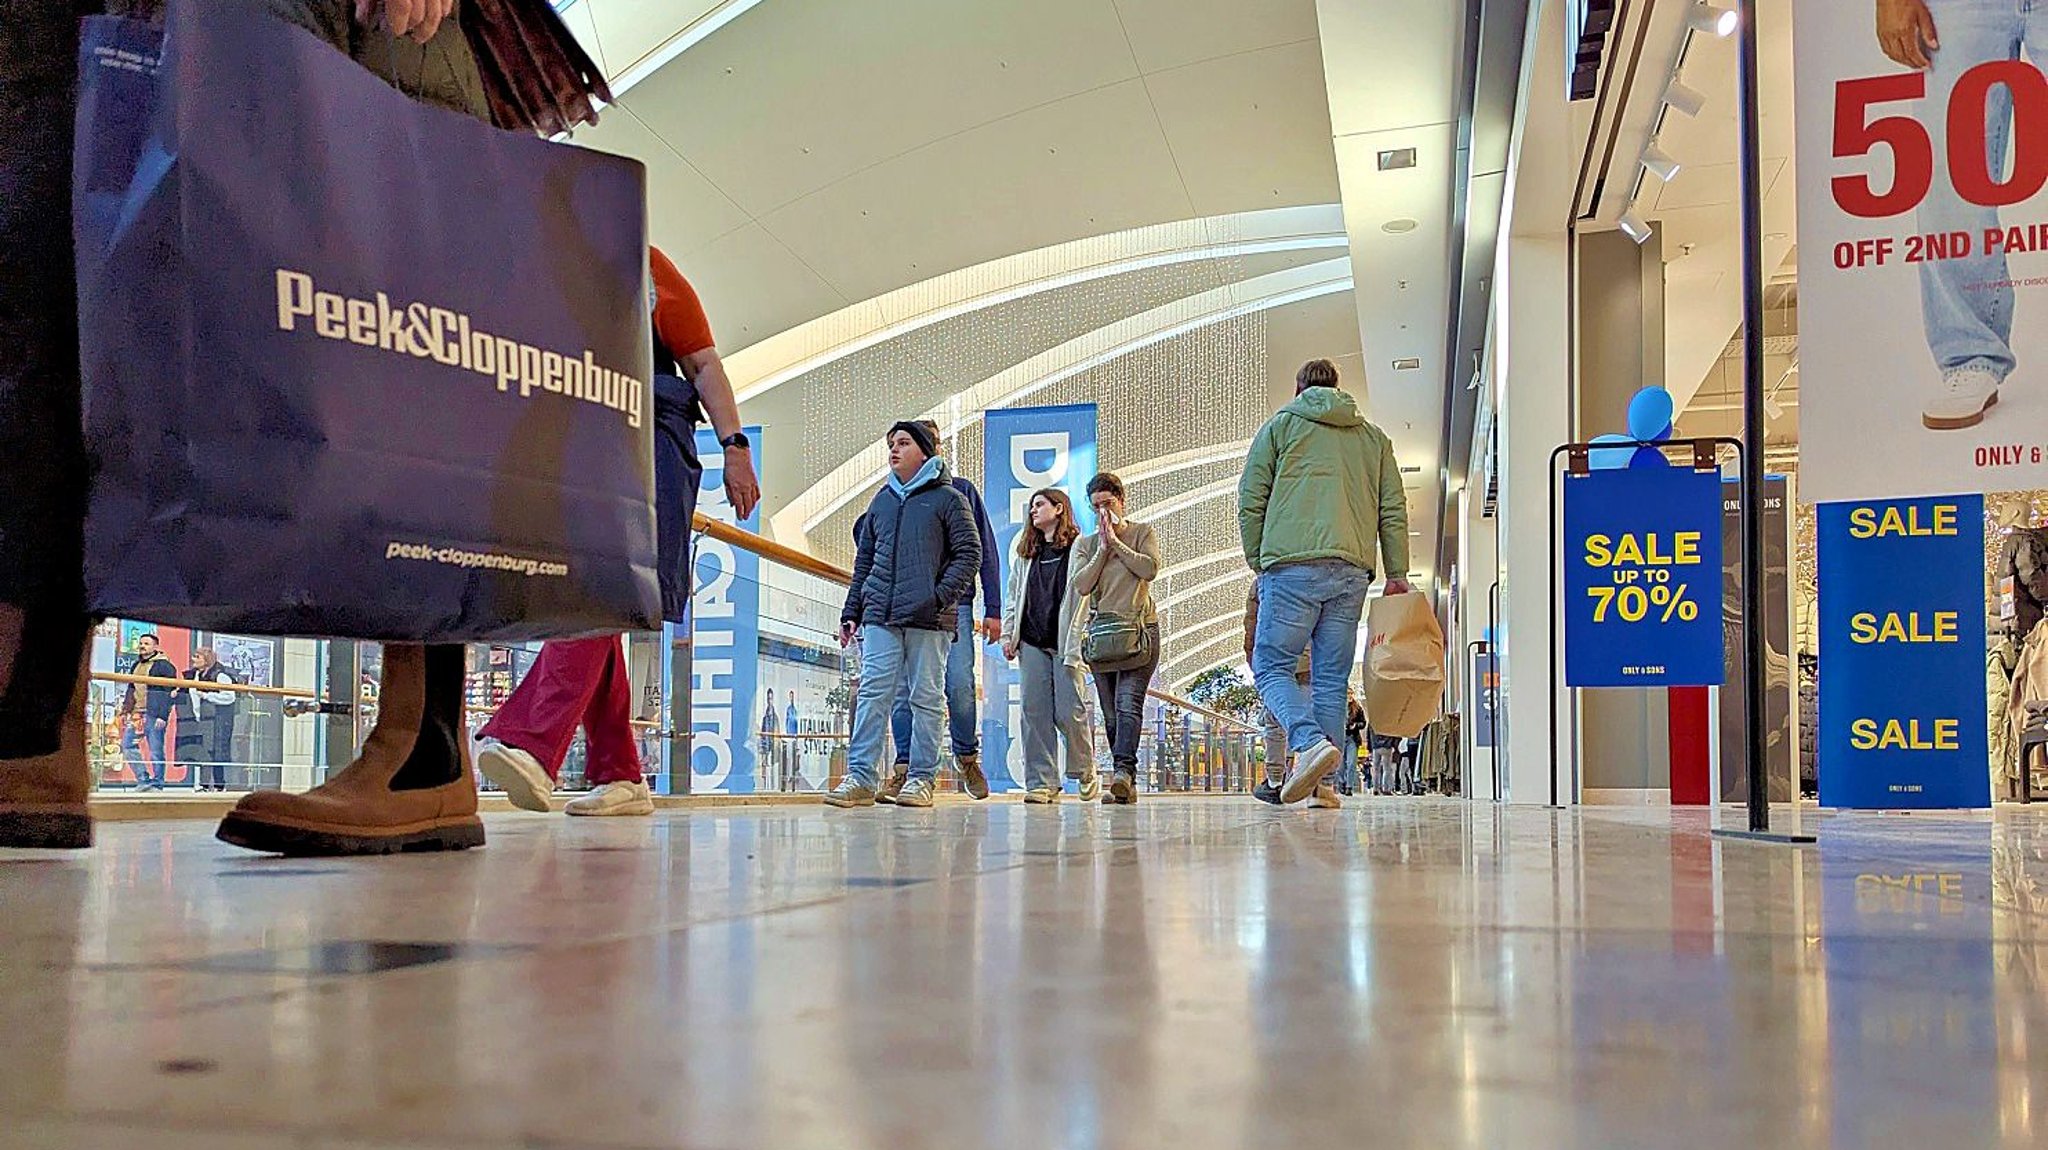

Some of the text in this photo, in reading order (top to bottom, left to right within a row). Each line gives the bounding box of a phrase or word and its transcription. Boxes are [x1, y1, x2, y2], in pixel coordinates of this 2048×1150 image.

[1833, 237, 1894, 269] OFF
[1904, 231, 1971, 263] 2ND
[1975, 445, 2041, 467] ONLY &
[1849, 505, 1958, 538] SALE
[386, 542, 568, 576] peek-cloppenburg.com
[1584, 531, 1701, 567] SALE
[1613, 569, 1670, 584] UP TO
[1587, 584, 1698, 622] 70%
[1850, 611, 1958, 643] SALE
[800, 718, 833, 735] ITALIAN
[1850, 718, 1960, 750] SALE
[804, 738, 829, 755] STYLE
